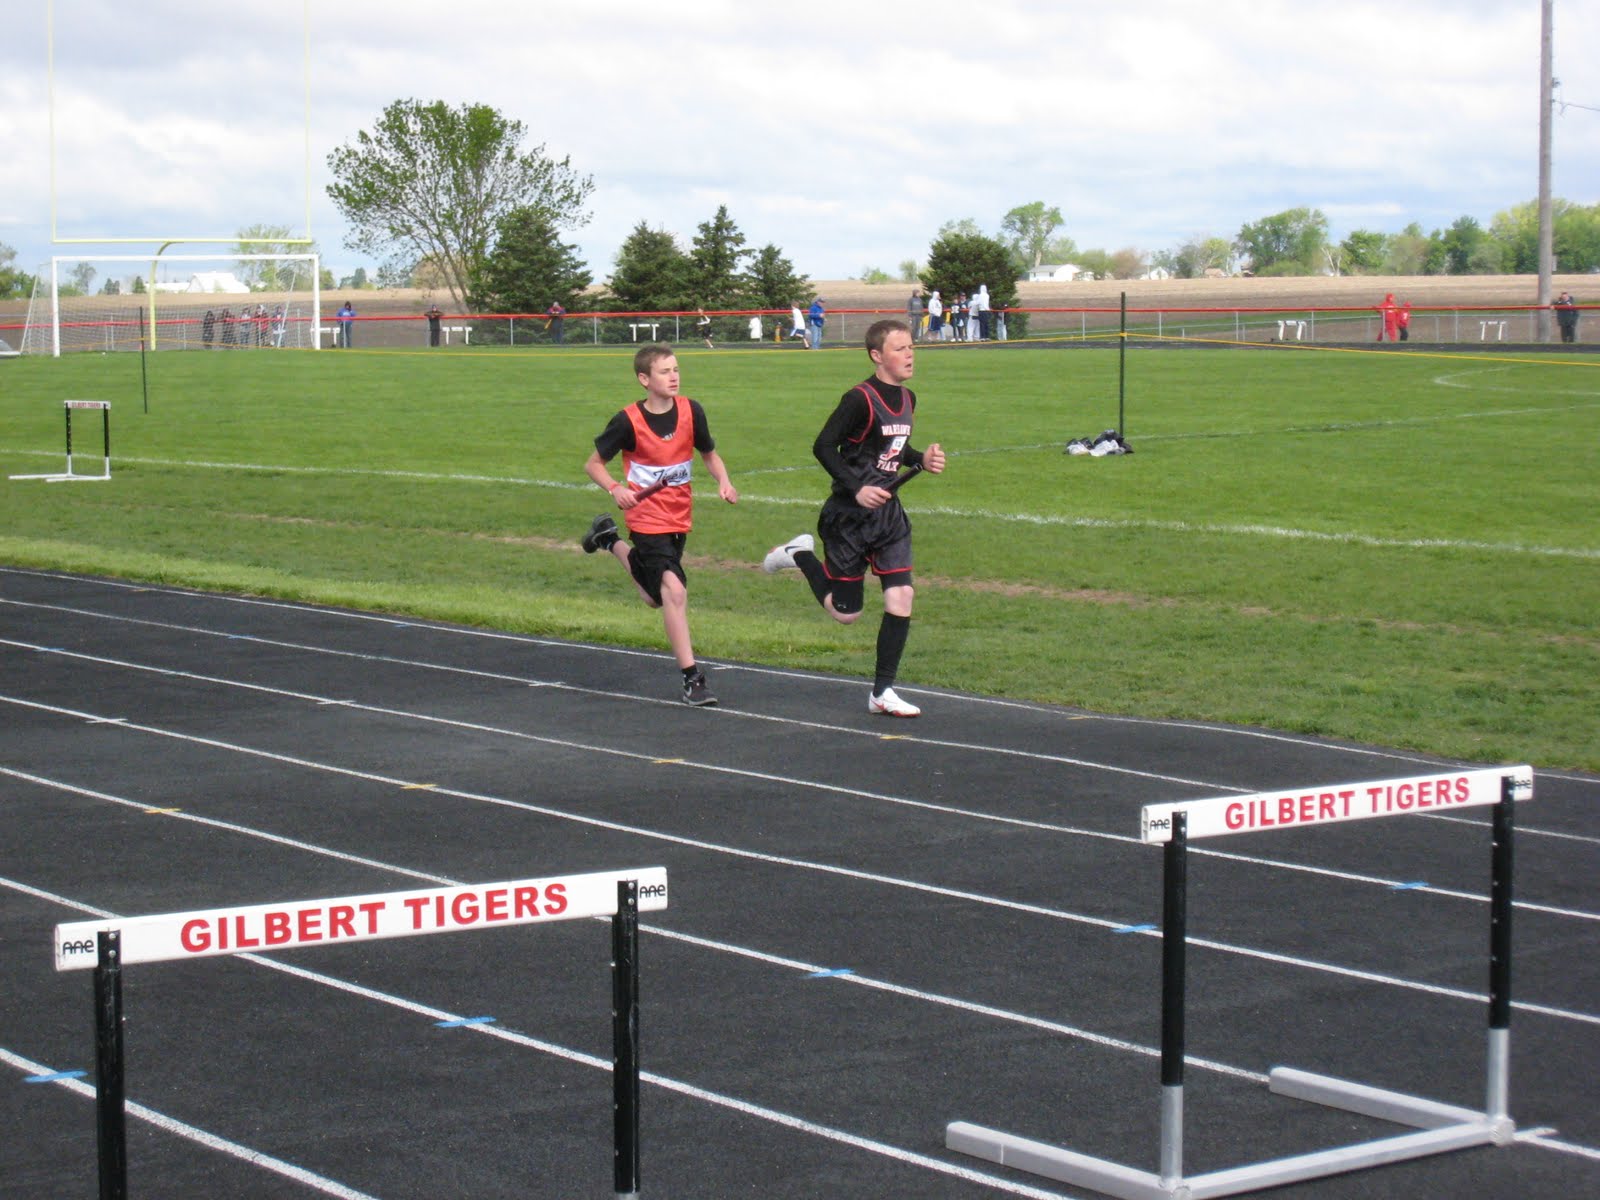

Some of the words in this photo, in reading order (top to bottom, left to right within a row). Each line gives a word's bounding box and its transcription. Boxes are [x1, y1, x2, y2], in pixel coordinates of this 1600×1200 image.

[1226, 790, 1355, 830] GILBERT
[1367, 777, 1469, 811] TIGERS
[181, 901, 386, 950] GILBERT
[404, 883, 567, 927] TIGERS
